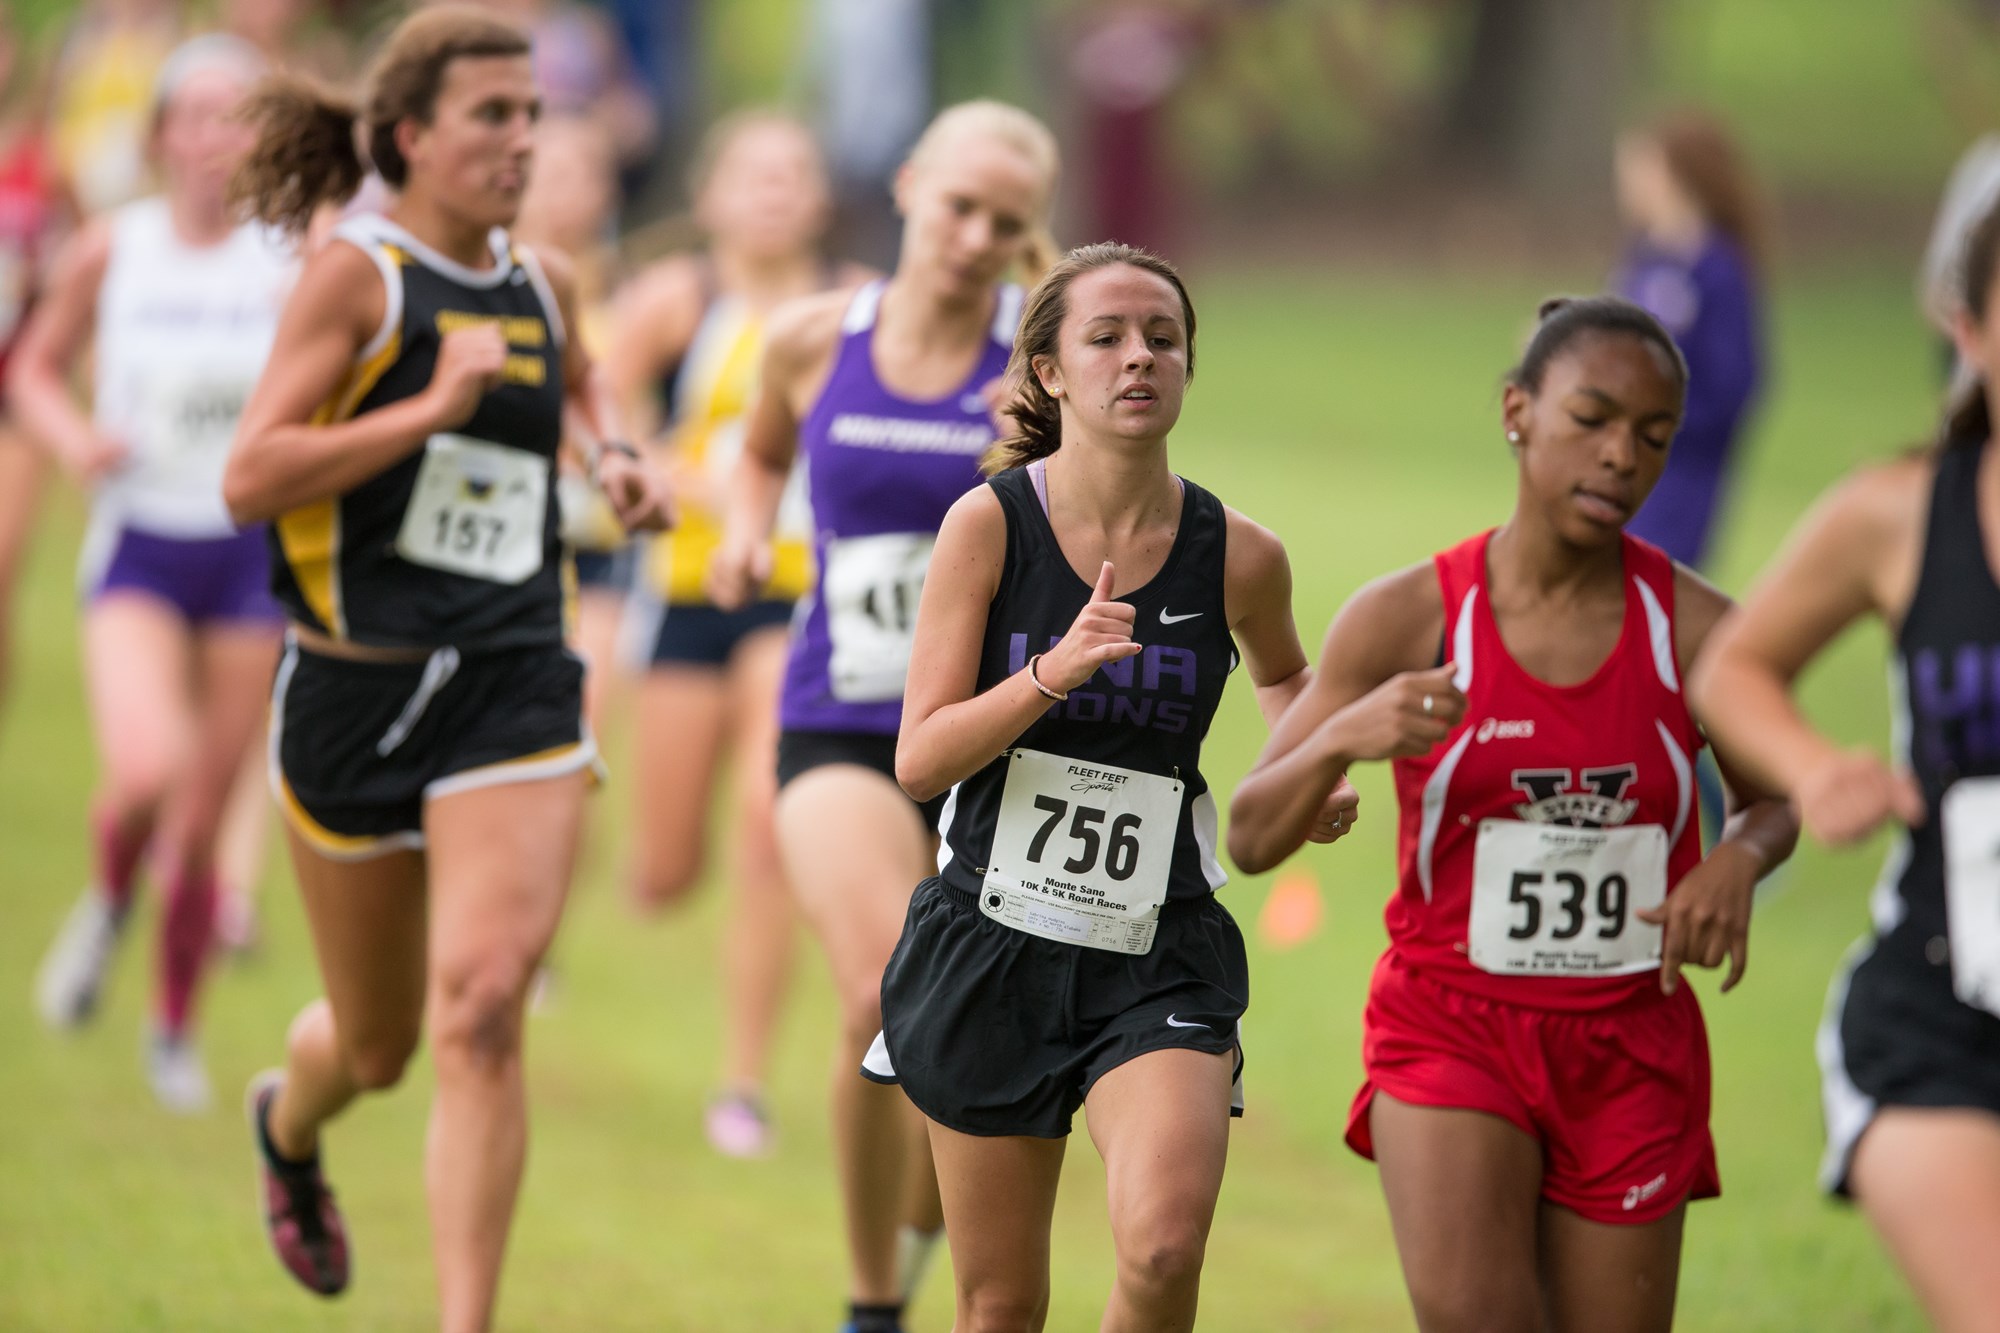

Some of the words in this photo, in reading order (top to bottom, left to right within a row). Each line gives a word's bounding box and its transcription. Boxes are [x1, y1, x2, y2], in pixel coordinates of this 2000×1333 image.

[433, 506, 506, 559] 157
[1067, 766, 1101, 780] FLEET
[1101, 772, 1128, 785] FEET
[1070, 778, 1118, 794] Sports
[1543, 799, 1611, 818] STATE
[1026, 794, 1143, 881] 756
[1020, 880, 1039, 891] 10K
[1041, 886, 1049, 895] &
[1052, 889, 1065, 899] 5K
[1068, 892, 1095, 905] Road
[1096, 898, 1128, 912] Races
[1044, 877, 1077, 892] Monte
[1079, 885, 1105, 898] Sano
[1508, 870, 1628, 940] 539
[1101, 936, 1117, 945] 0756
